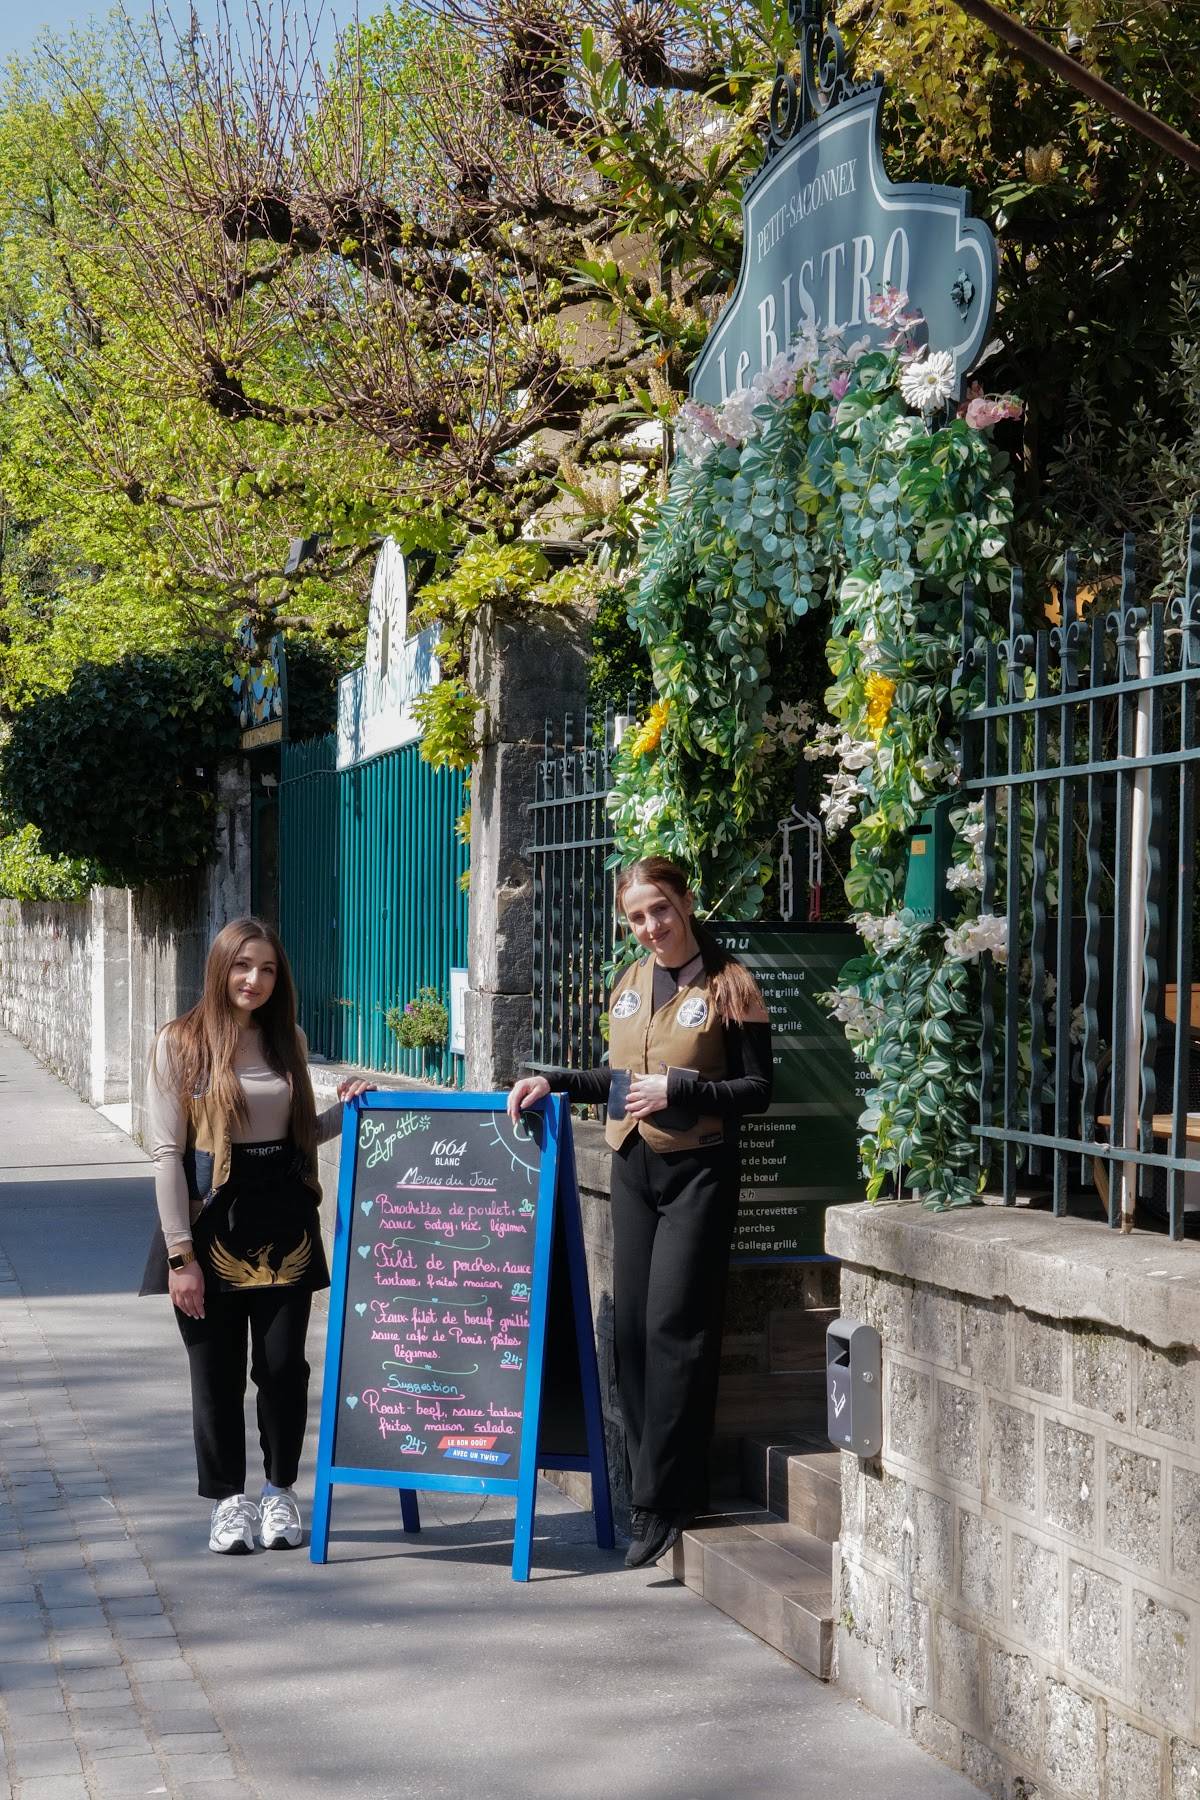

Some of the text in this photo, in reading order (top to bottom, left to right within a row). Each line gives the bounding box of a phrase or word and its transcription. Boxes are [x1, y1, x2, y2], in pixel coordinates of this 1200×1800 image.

[756, 158, 858, 264] PETIT-SACONNEX
[757, 227, 911, 374] BISTRO
[777, 972, 804, 980] chaud
[776, 988, 799, 998] grillé
[778, 1023, 802, 1032] grillé
[359, 1119, 384, 1149] Bon
[748, 1123, 796, 1132] Parisienne
[430, 1138, 468, 1156] 1664
[750, 1139, 774, 1148] bœuf
[762, 1156, 786, 1165] bœuf
[397, 1167, 499, 1186] Menus du Jour
[740, 1173, 778, 1182] de bœuf
[376, 1194, 442, 1214] Brochettes
[449, 1202, 465, 1215] de
[756, 1207, 798, 1216] crevettes
[379, 1219, 416, 1230] sauce
[490, 1218, 527, 1237] légumes
[739, 1224, 776, 1234] perches
[738, 1241, 772, 1251] Gallega
[773, 1240, 797, 1250] grillé
[375, 1243, 417, 1268] Filet
[426, 1254, 445, 1270] de
[503, 1262, 532, 1274] sauce
[427, 1274, 457, 1288] frites
[443, 1312, 458, 1324] de
[371, 1330, 400, 1340] sauce
[406, 1326, 428, 1344] café
[432, 1330, 447, 1341] de
[387, 1374, 458, 1394] Suggestion
[453, 1408, 485, 1417] sauce
[379, 1417, 411, 1439] frites
